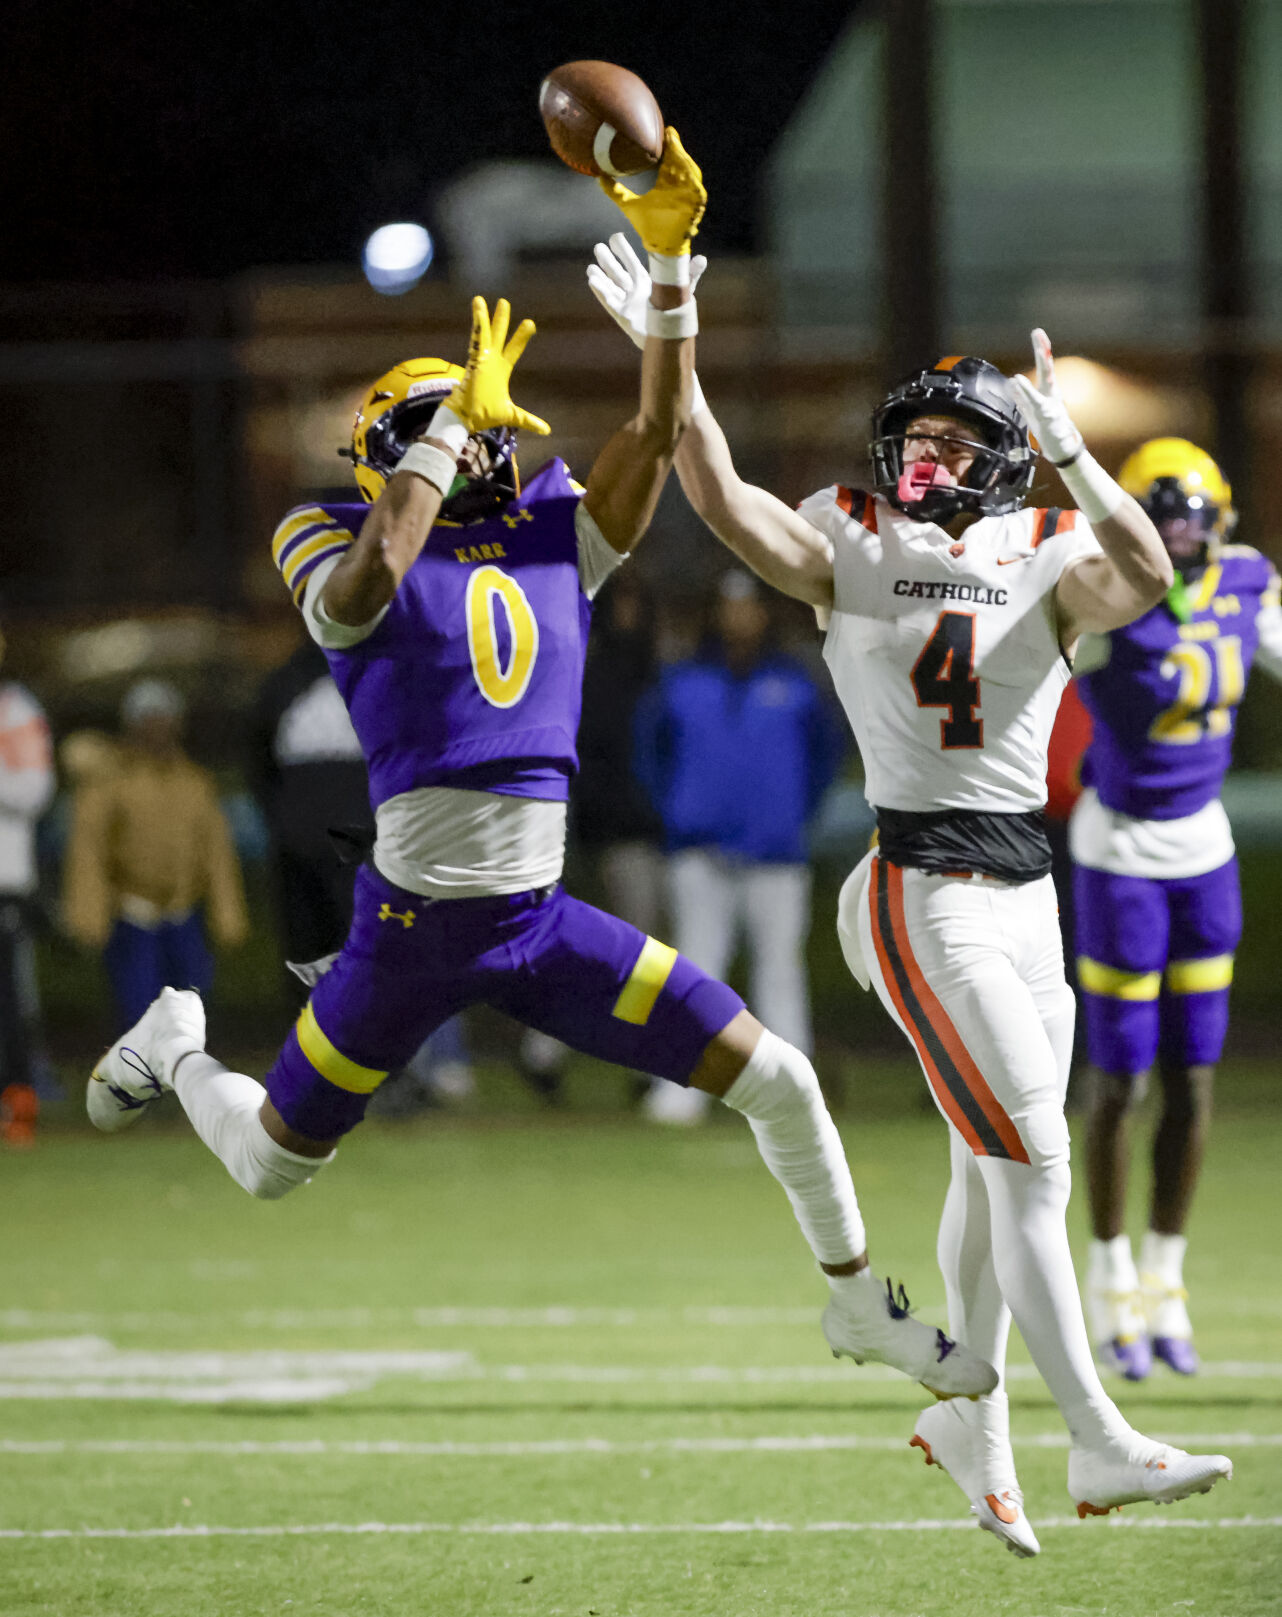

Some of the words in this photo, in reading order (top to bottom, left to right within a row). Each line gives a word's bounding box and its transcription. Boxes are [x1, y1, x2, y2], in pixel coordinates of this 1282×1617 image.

[454, 542, 507, 563] KARR
[893, 579, 1008, 606] CATHOLIC
[465, 564, 540, 709] 0
[909, 610, 984, 750] 4
[1147, 634, 1245, 745] 21
